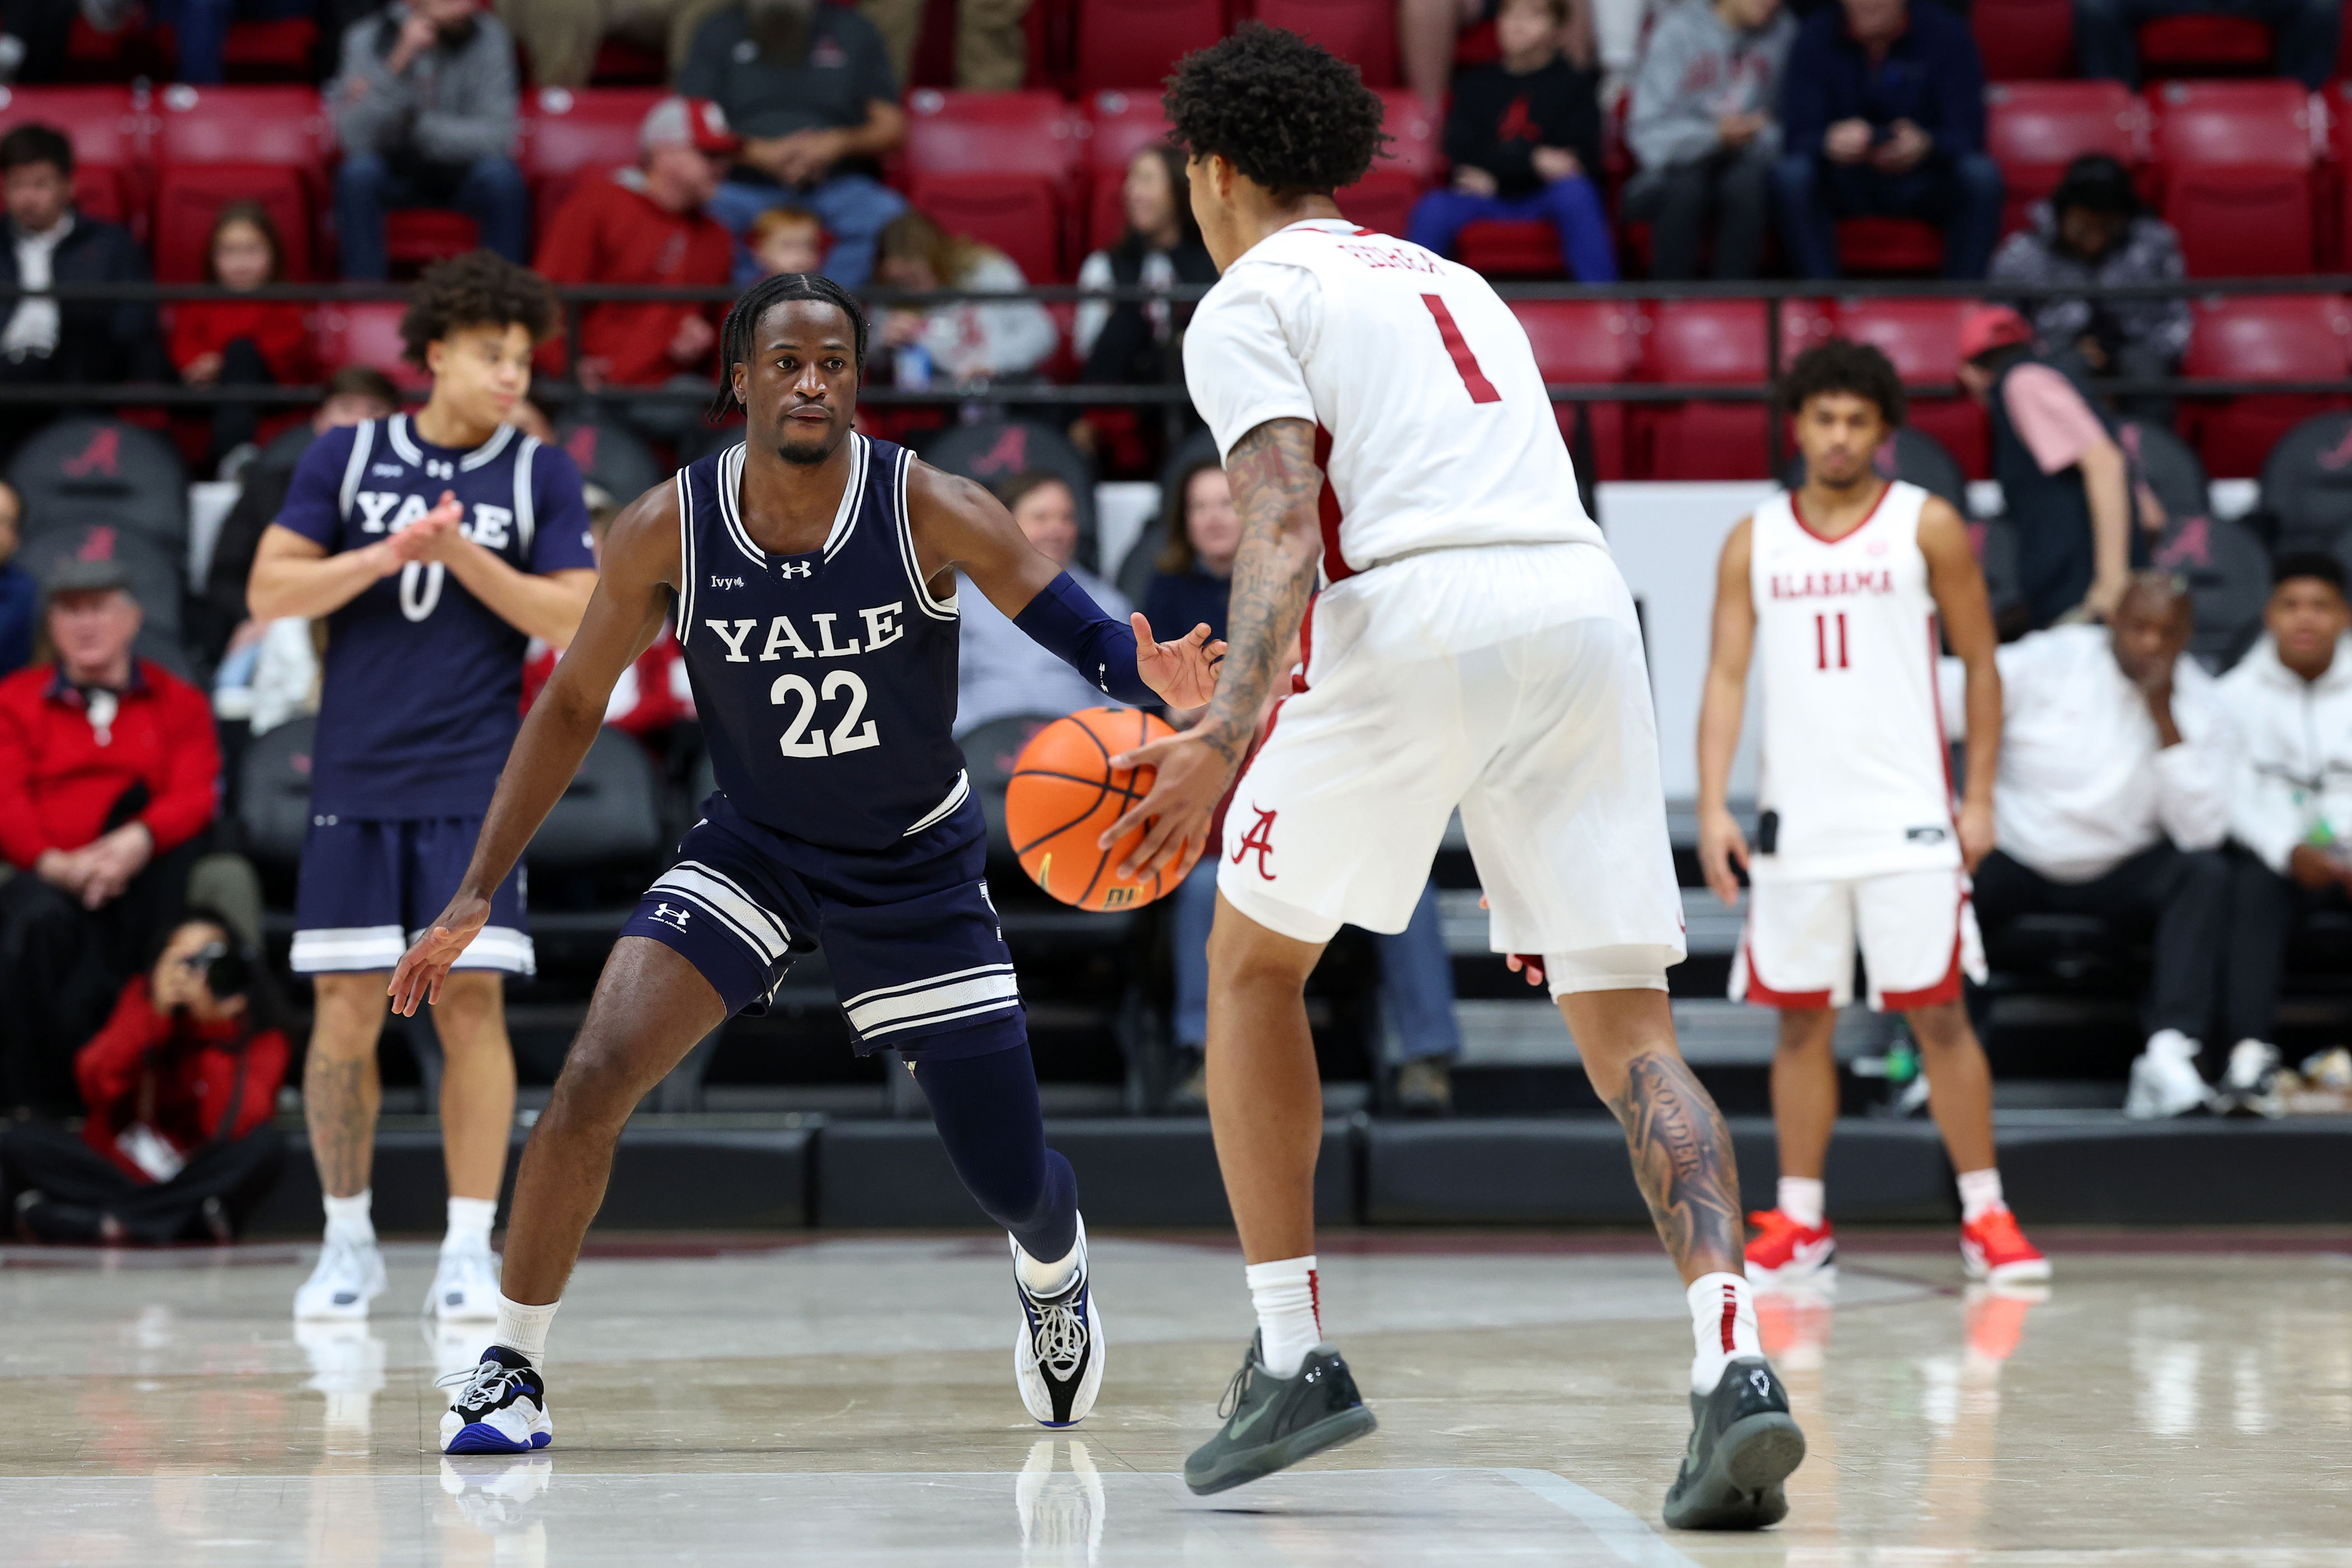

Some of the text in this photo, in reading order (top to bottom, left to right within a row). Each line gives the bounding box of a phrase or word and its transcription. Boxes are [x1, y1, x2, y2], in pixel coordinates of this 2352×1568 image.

[1419, 292, 1502, 404] 1
[711, 575, 733, 591] Ivy
[1770, 570, 1894, 599] ALABAMA
[705, 600, 904, 663] YALE
[1815, 612, 1849, 669] 11
[770, 669, 880, 758] 22
[1232, 800, 1278, 881] A
[664, 920, 687, 934] ARMOUR
[1651, 1075, 1702, 1177] SONDER
